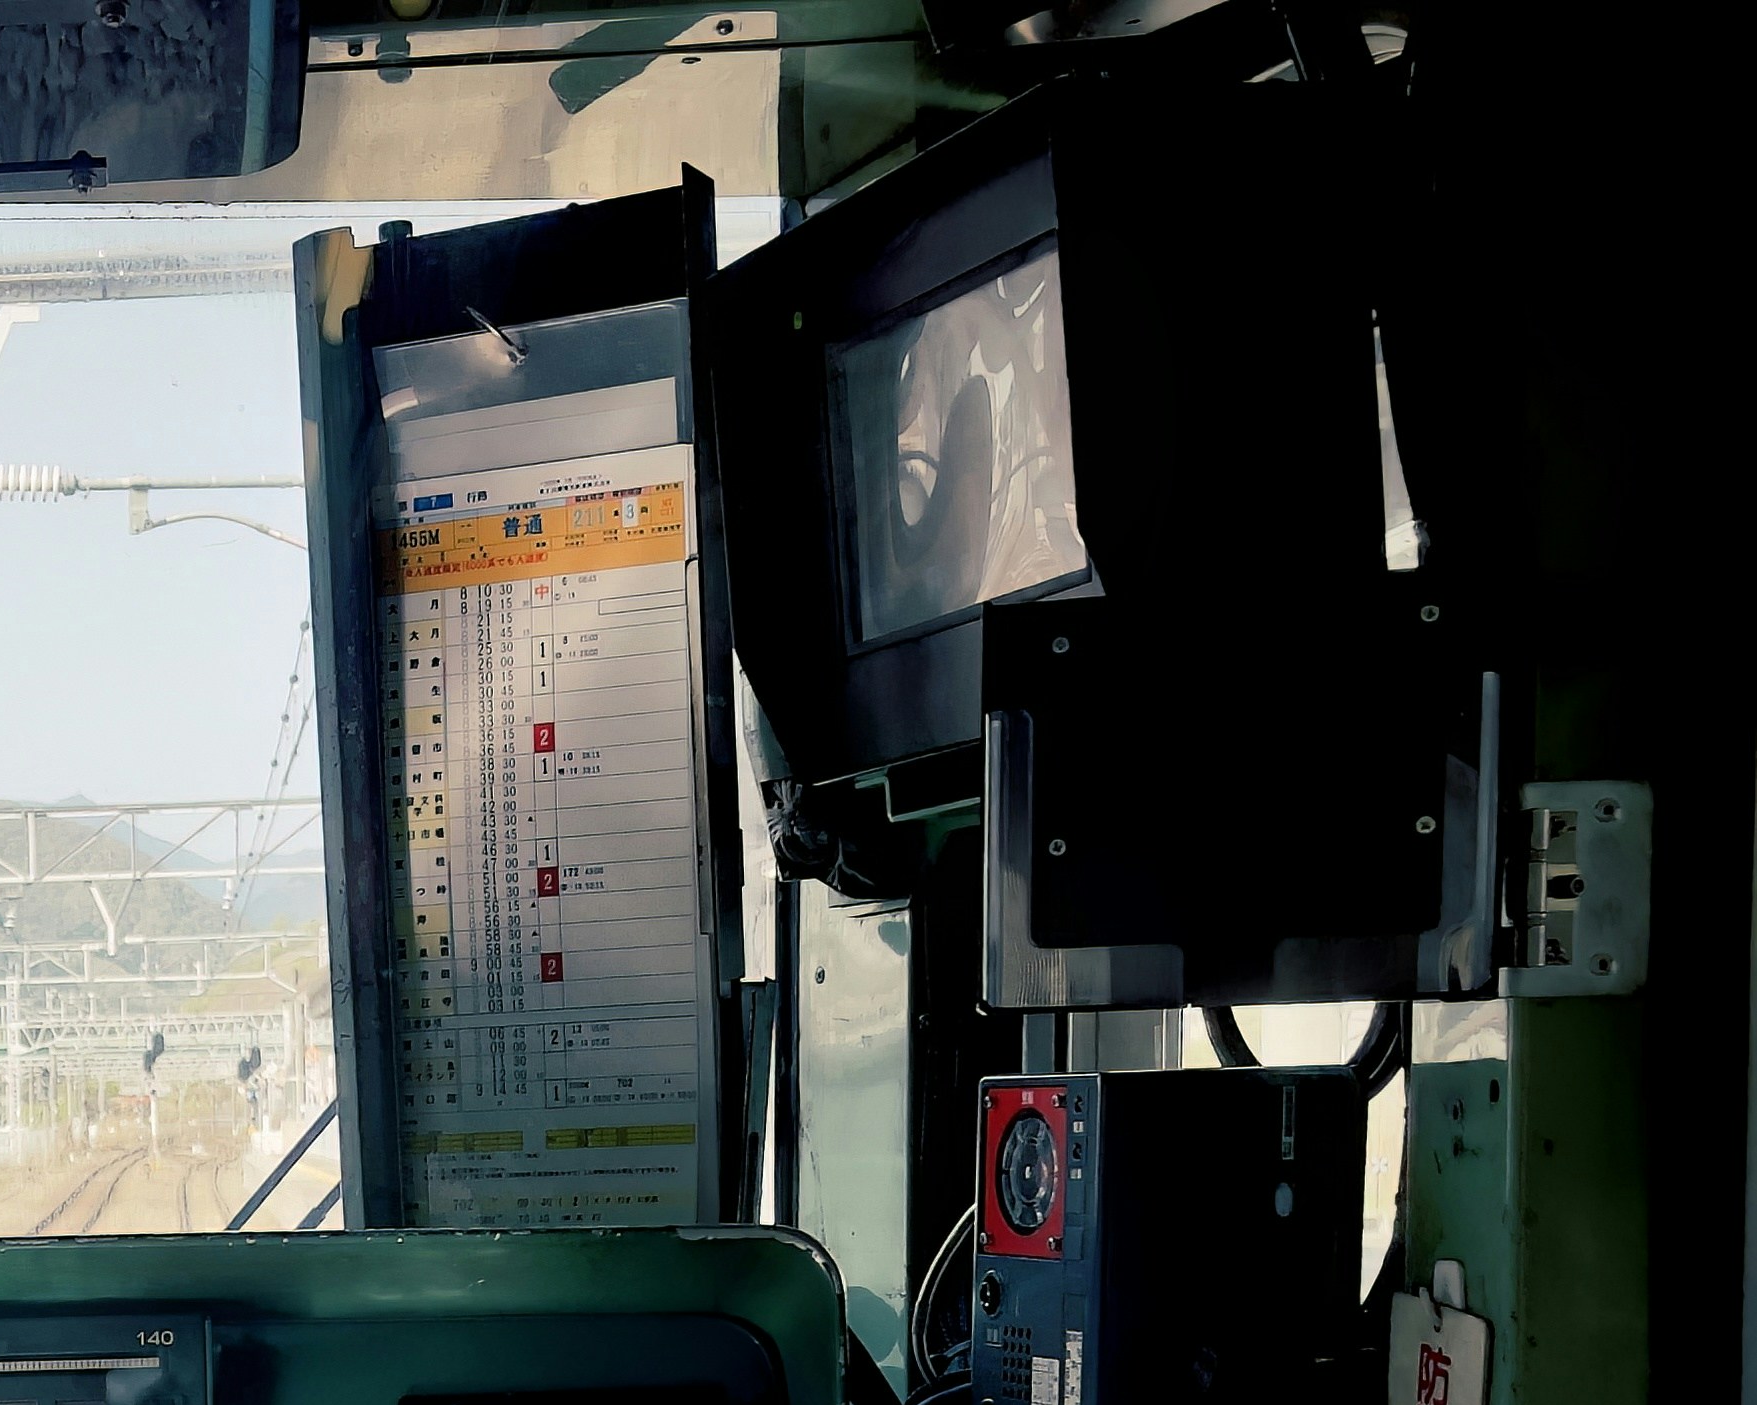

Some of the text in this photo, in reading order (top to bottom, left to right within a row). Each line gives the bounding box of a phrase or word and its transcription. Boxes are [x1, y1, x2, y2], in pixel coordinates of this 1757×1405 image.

[502, 513, 542, 538] 普通
[574, 505, 604, 527] 211
[626, 503, 635, 519] 3
[460, 586, 467, 600] 8
[478, 584, 492, 599] 10
[500, 584, 513, 595] 30
[534, 584, 549, 600] 中
[460, 597, 512, 614] 8 19 15
[477, 614, 490, 627] 21
[501, 612, 512, 624] 15
[477, 626, 513, 642] 21 45
[477, 642, 492, 656] 25
[500, 642, 513, 653] 30
[478, 656, 514, 670] 26 00
[478, 671, 493, 685] 30
[502, 671, 514, 682] 15
[478, 685, 514, 699] 30 45
[478, 699, 514, 714] 33 00
[479, 714, 515, 728] 33 30
[479, 728, 549, 746] 36 15 2
[479, 743, 515, 757] 36 45
[479, 757, 494, 771] 38
[502, 758, 515, 769] 30
[480, 772, 516, 786] 39 00
[480, 786, 516, 799] 41 30
[480, 800, 516, 814] 42 00
[480, 814, 517, 828] 43 30
[481, 829, 517, 843] 43 45
[481, 843, 550, 861] 46 30 1
[482, 858, 518, 871] 47 00
[483, 872, 496, 885] 51
[505, 872, 518, 883] 00
[544, 874, 552, 889] 2
[484, 886, 519, 900] 51 30
[484, 900, 519, 913] 56 15
[484, 914, 520, 928] 56 30
[485, 929, 521, 942] 58 30
[486, 943, 522, 956] 58 45
[470, 958, 478, 972] 9
[486, 957, 502, 970] 00
[509, 957, 522, 968] 45
[547, 959, 556, 975] 2
[487, 971, 523, 985] 01 15
[550, 1029, 559, 1045] 2
[476, 1083, 483, 1096] 9
[136, 1330, 174, 1346] 140
